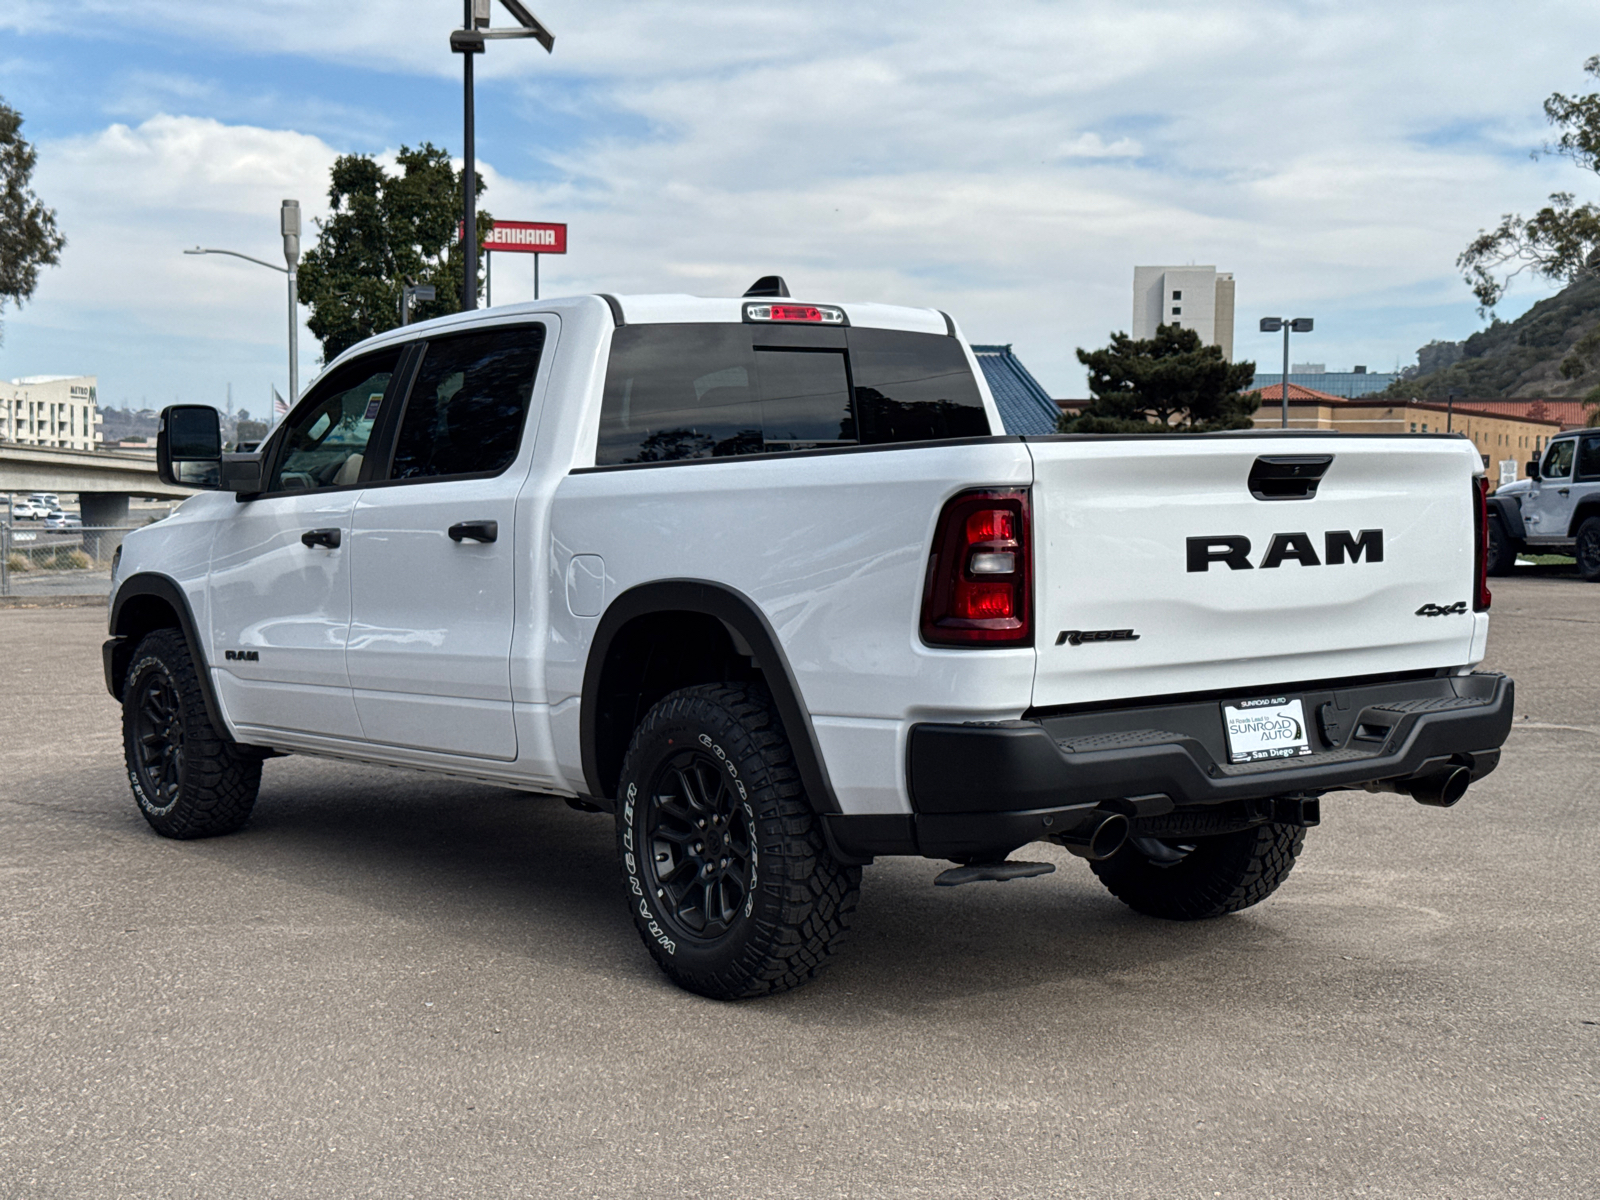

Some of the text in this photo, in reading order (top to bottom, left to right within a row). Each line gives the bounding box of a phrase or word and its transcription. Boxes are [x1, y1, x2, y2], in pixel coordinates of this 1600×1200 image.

[484, 227, 556, 245] BENIHANA
[1186, 528, 1384, 573] RAM
[1055, 629, 1141, 646] REBEL
[225, 650, 259, 661] RAM
[1241, 699, 1270, 707] SUNROAD
[1230, 719, 1291, 735] SUNROAD
[1261, 729, 1293, 741] AUTO
[1252, 751, 1268, 759] San
[1269, 748, 1294, 757] Diego
[699, 733, 758, 918] GOODYEAR
[624, 782, 676, 955] WRANGLER
